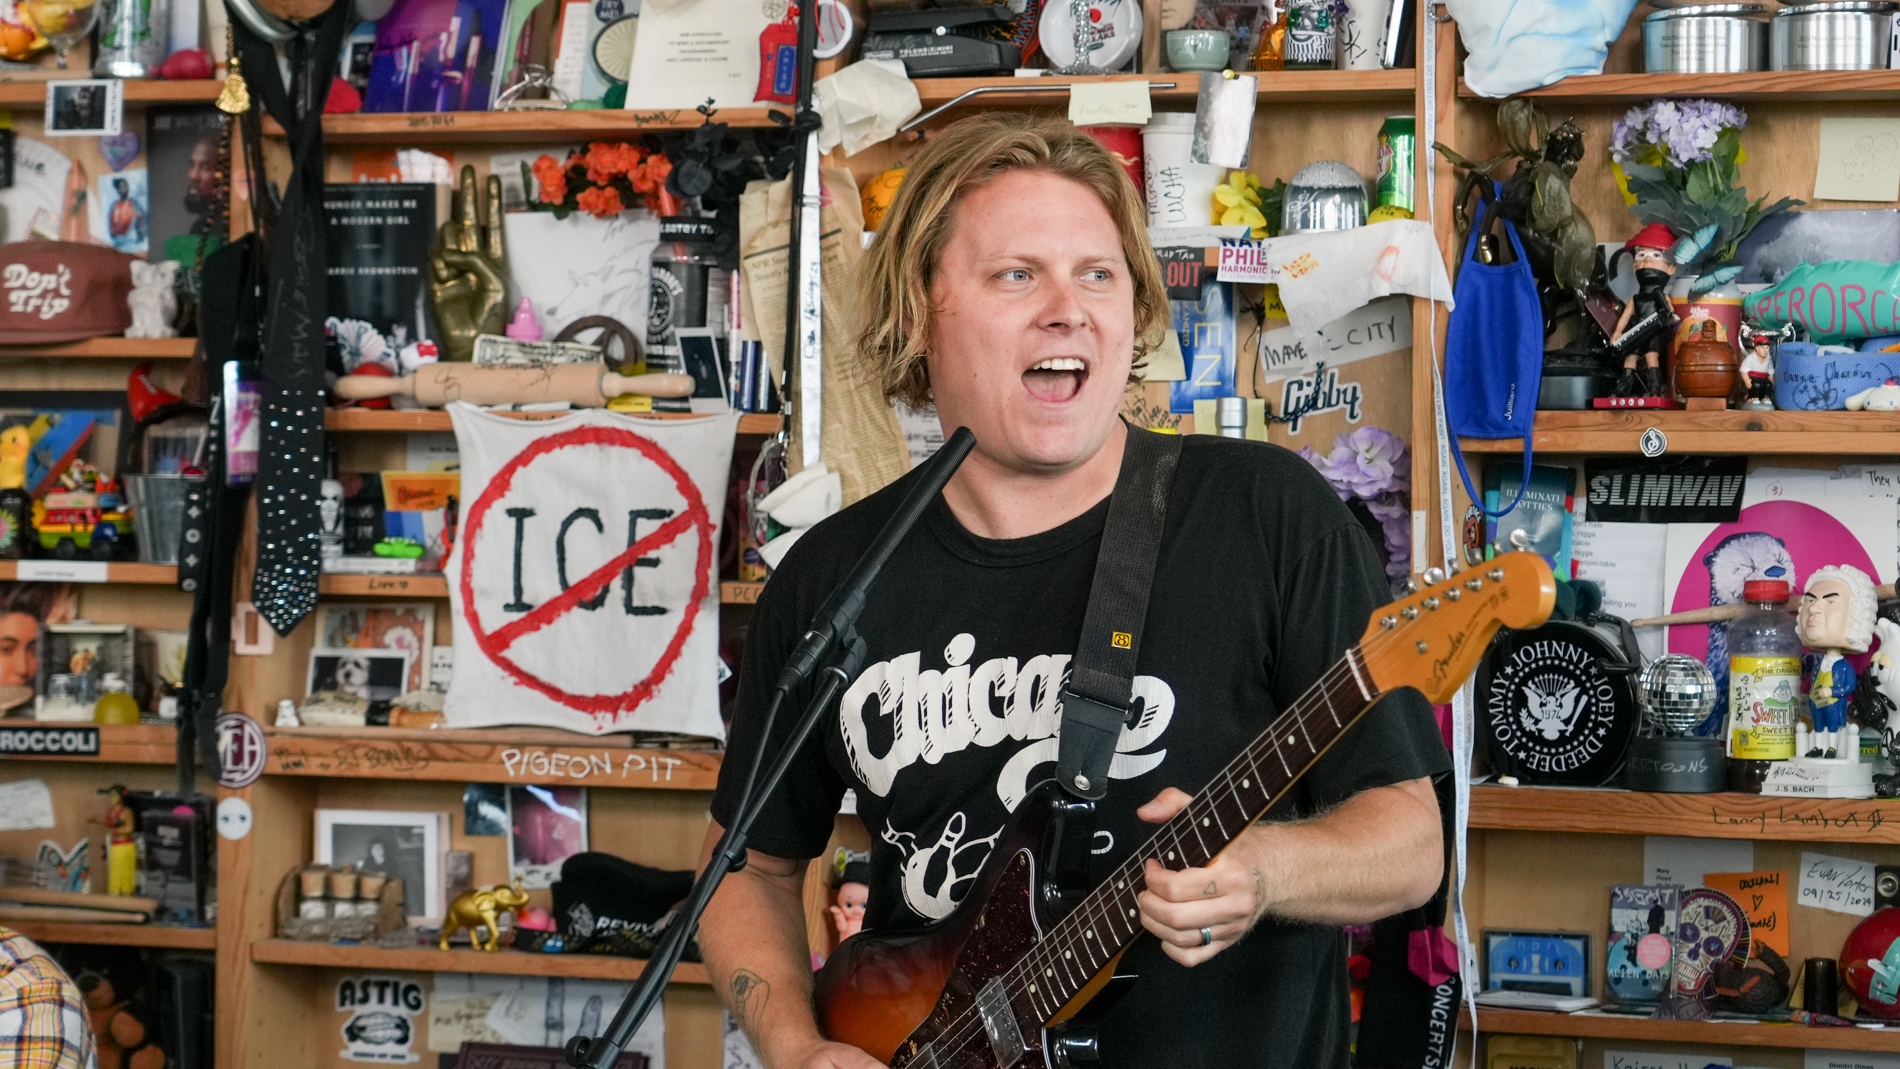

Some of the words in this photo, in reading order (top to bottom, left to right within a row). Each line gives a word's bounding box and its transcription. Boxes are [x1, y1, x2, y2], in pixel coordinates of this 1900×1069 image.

[3, 263, 72, 297] Don't
[1221, 265, 1268, 275] HARMONIC
[9, 290, 70, 320] Trip
[1866, 470, 1891, 488] They
[503, 506, 674, 616] ICE
[1579, 560, 1617, 568] espectable
[1511, 640, 1595, 670] JOHNNY
[1489, 672, 1520, 756] TOMMY
[1541, 709, 1562, 719] 1974
[1592, 676, 1615, 729] JOEY
[1762, 726, 1790, 734] SWEET
[501, 749, 612, 780] PIGEON
[622, 753, 681, 782] PIT
[1608, 969, 1640, 979] ALIEN
[1646, 970, 1670, 980] DAYS
[339, 979, 422, 1011] ASTIG
